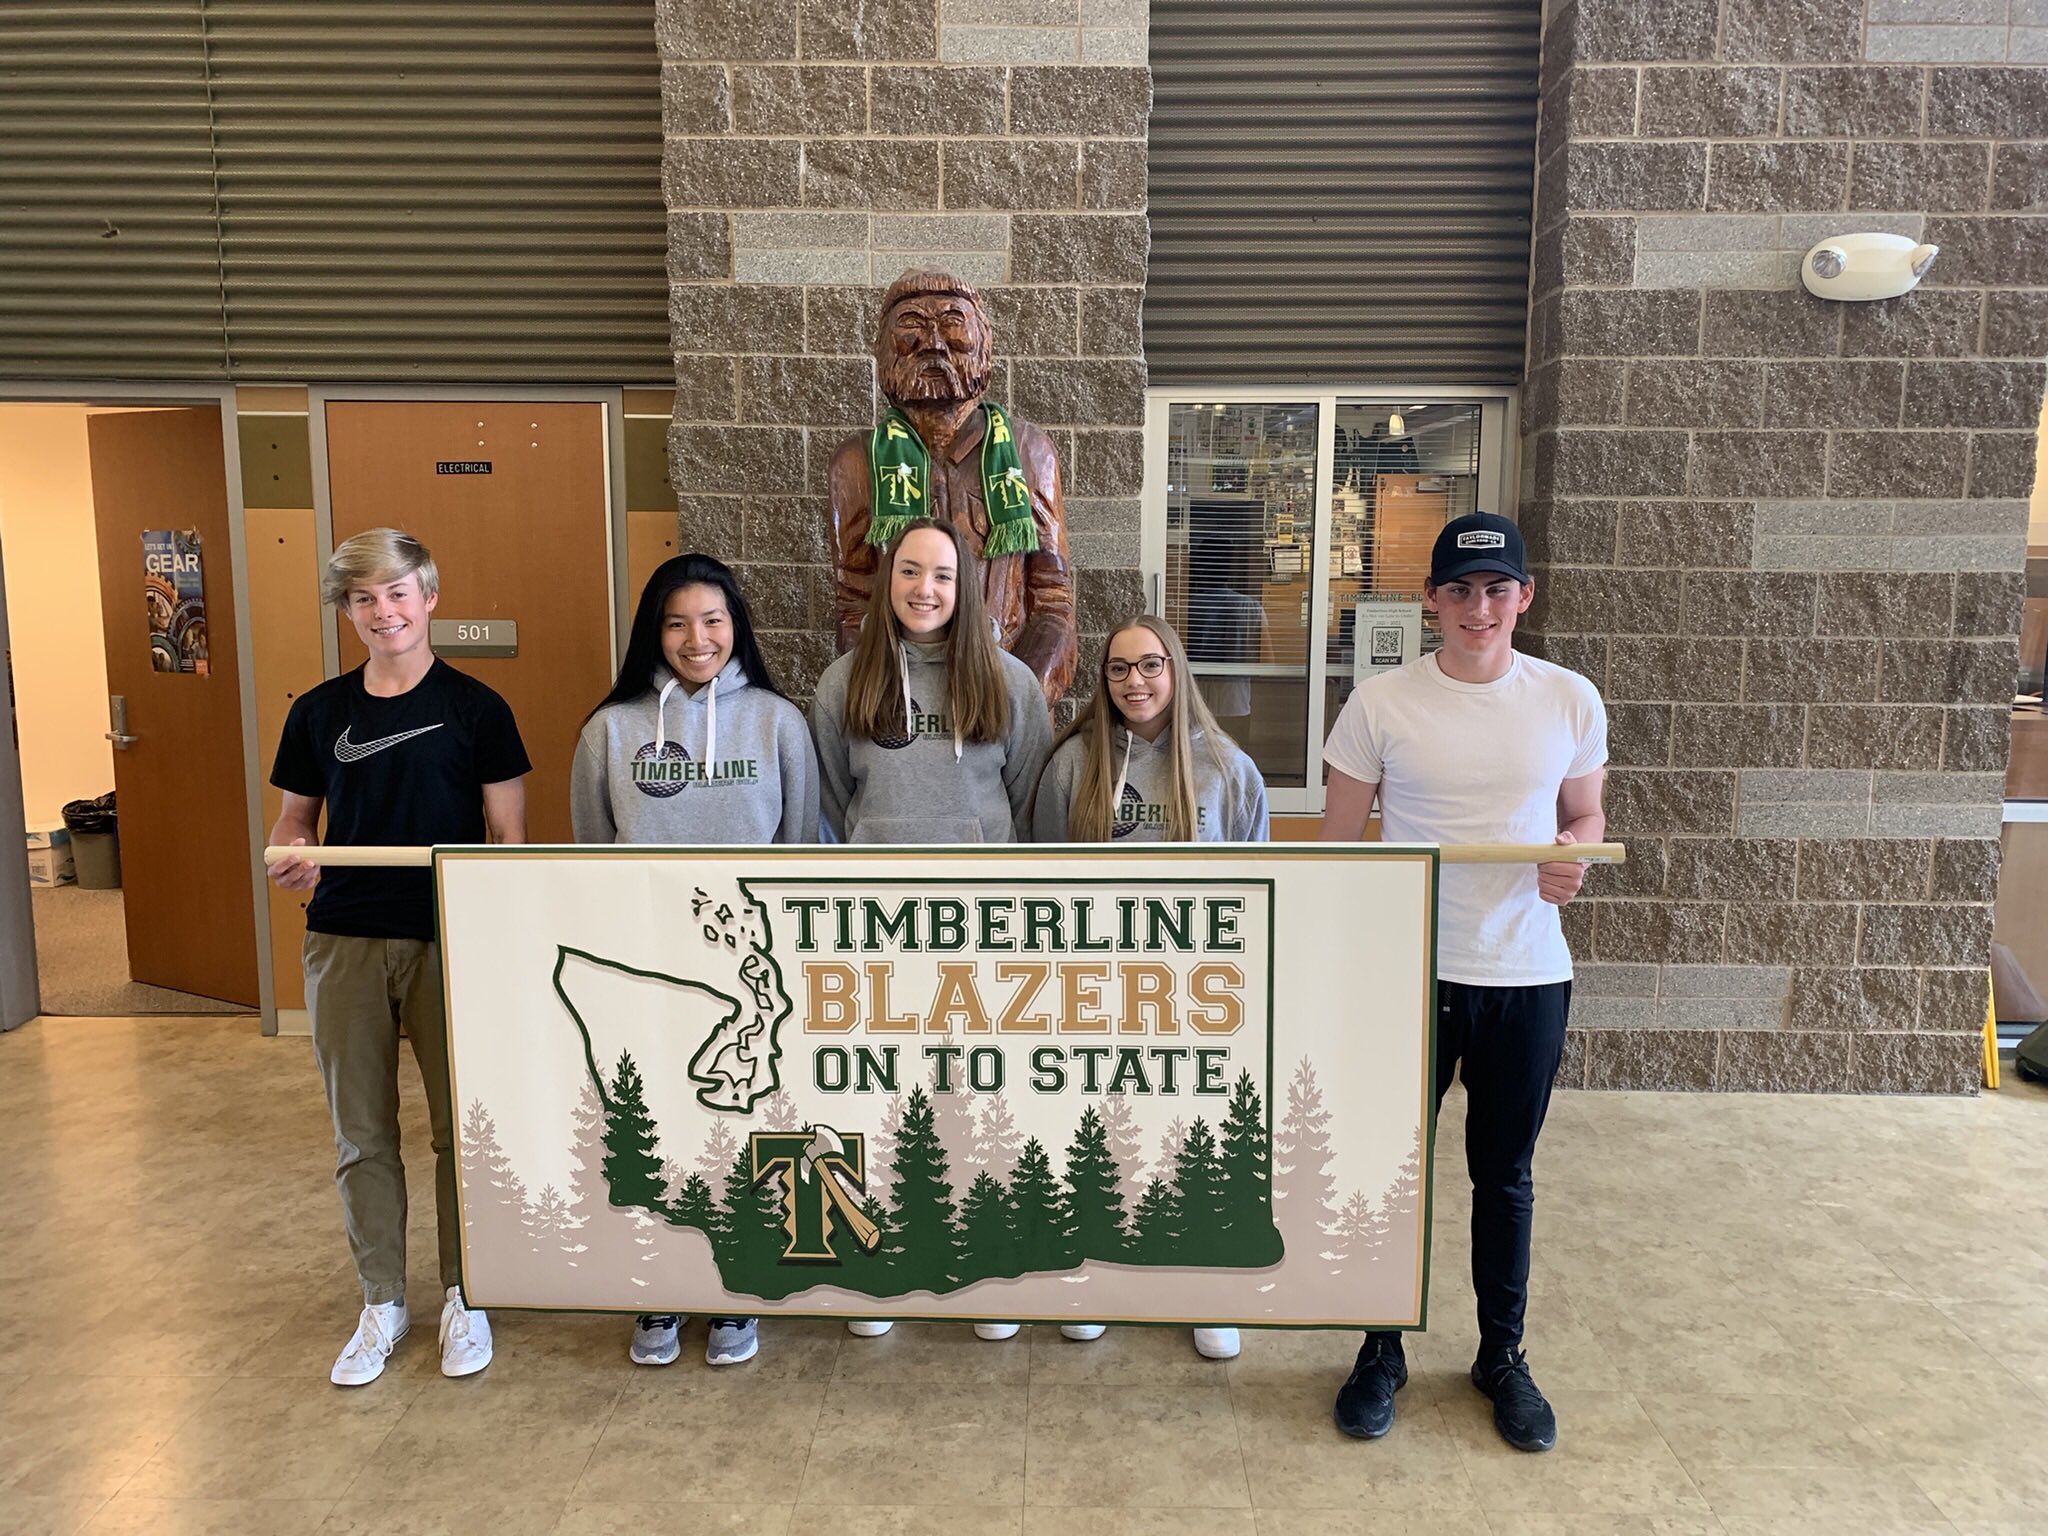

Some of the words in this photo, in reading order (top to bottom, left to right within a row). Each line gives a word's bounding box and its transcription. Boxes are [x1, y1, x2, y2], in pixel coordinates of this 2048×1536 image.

[438, 463, 490, 473] ELECTRICAL
[145, 553, 199, 573] GEAR
[457, 625, 490, 640] 501
[782, 897, 1246, 953] TIMBERLINE
[802, 961, 1246, 1036] BLAZERS
[812, 1044, 901, 1095] ON
[922, 1045, 1006, 1095] TO
[1029, 1045, 1231, 1096] STATE
